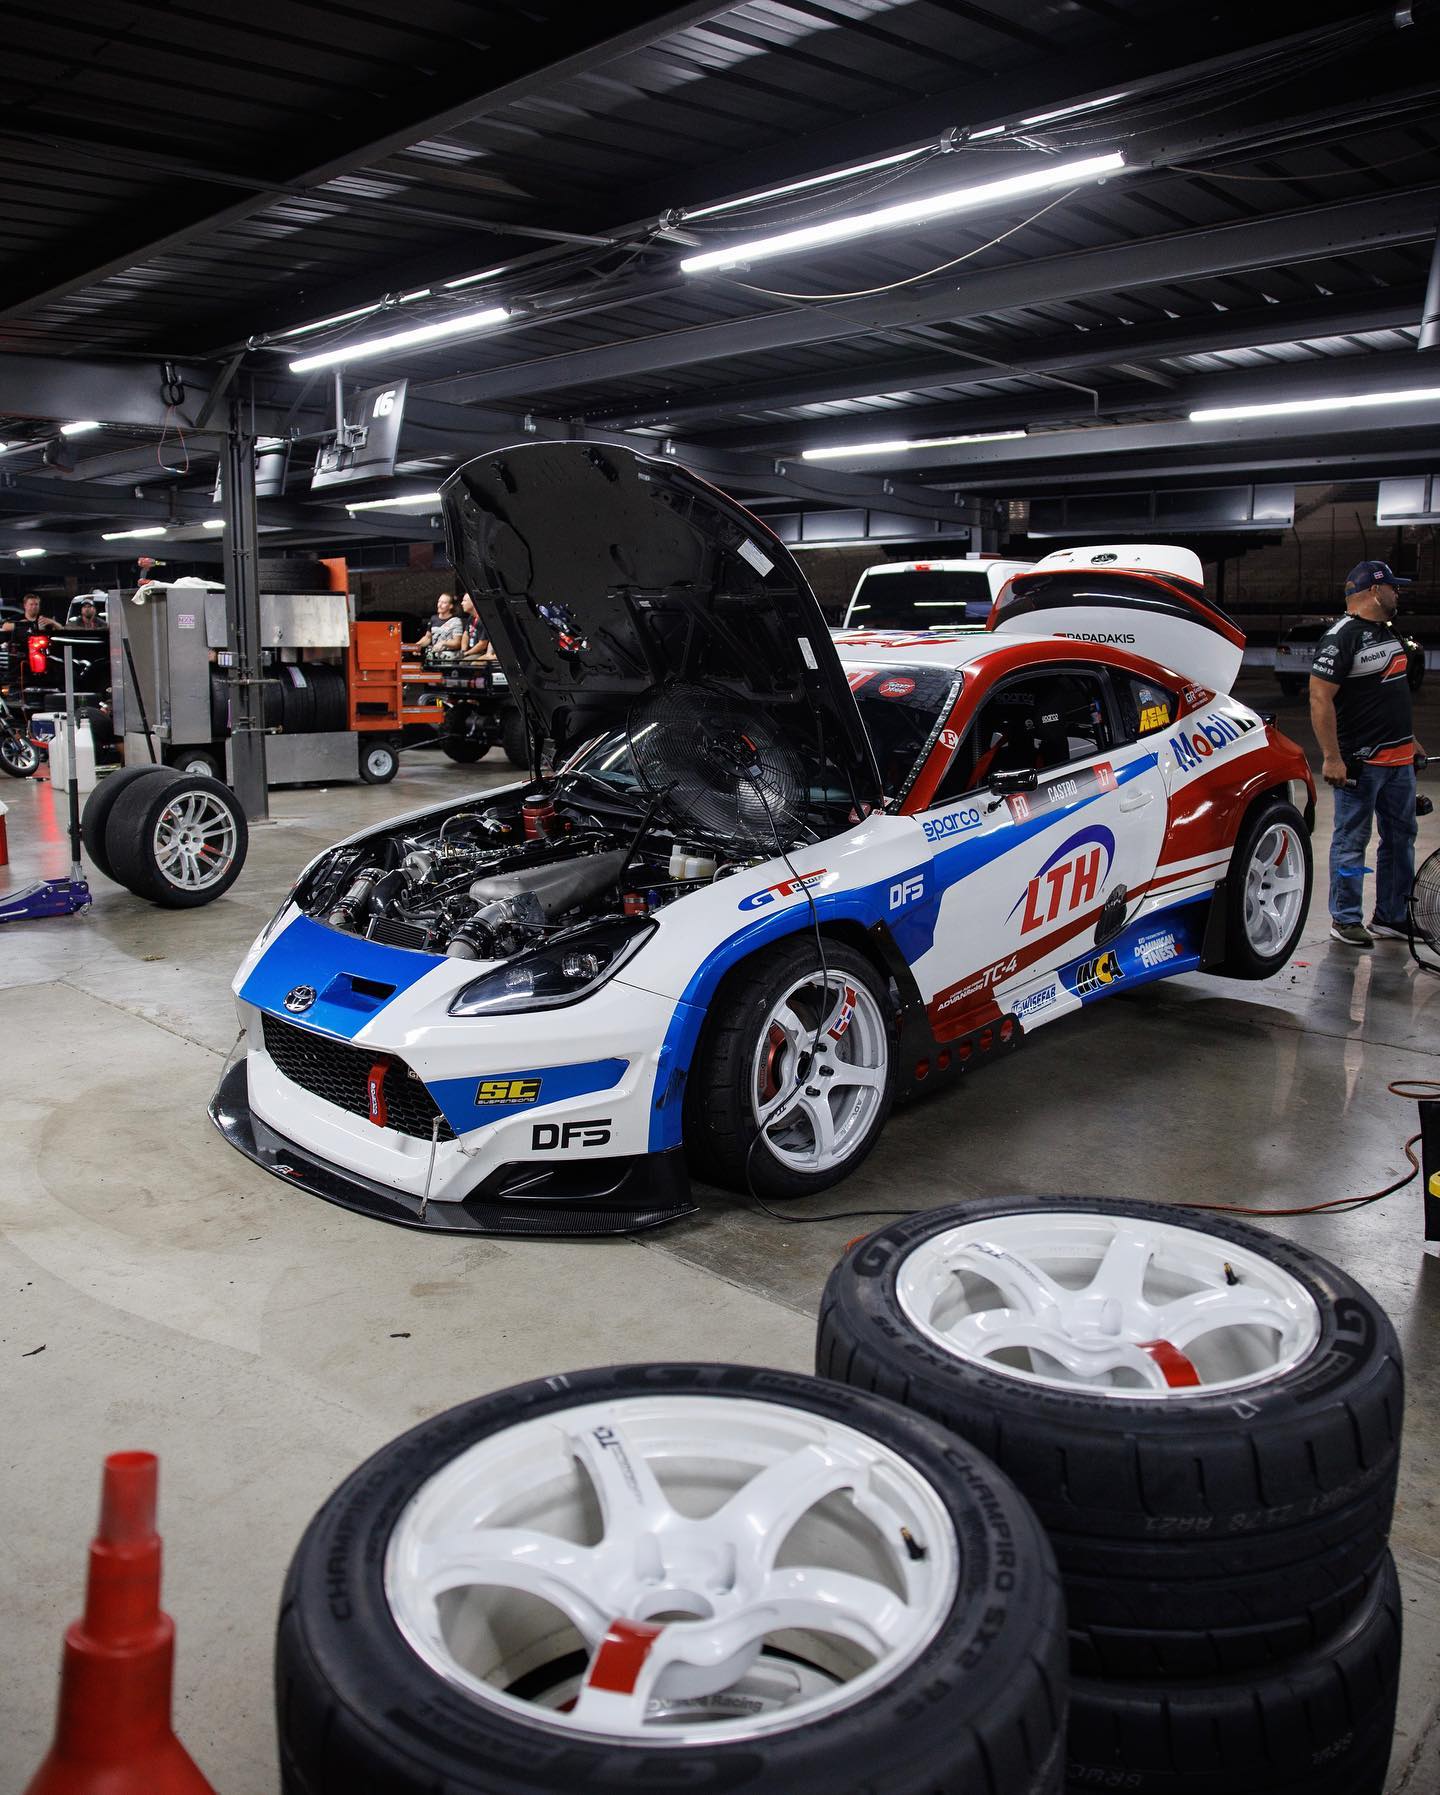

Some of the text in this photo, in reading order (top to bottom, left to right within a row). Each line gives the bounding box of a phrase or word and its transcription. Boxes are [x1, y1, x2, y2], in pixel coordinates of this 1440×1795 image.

[373, 390, 396, 417] 16
[1360, 652, 1380, 664] Mobil
[1139, 703, 1170, 733] AEM
[1169, 714, 1240, 772] Mobil
[1012, 768, 1110, 819] FD CASTRO 17
[922, 808, 982, 842] sparco
[738, 868, 828, 911] GT
[889, 873, 924, 910] DFS
[1020, 847, 1101, 936] LTH
[982, 954, 1018, 988] TC-4
[1141, 943, 1178, 968] FINEST
[532, 1118, 613, 1151] DFS
[942, 1447, 1018, 1593] CHAMPIRO
